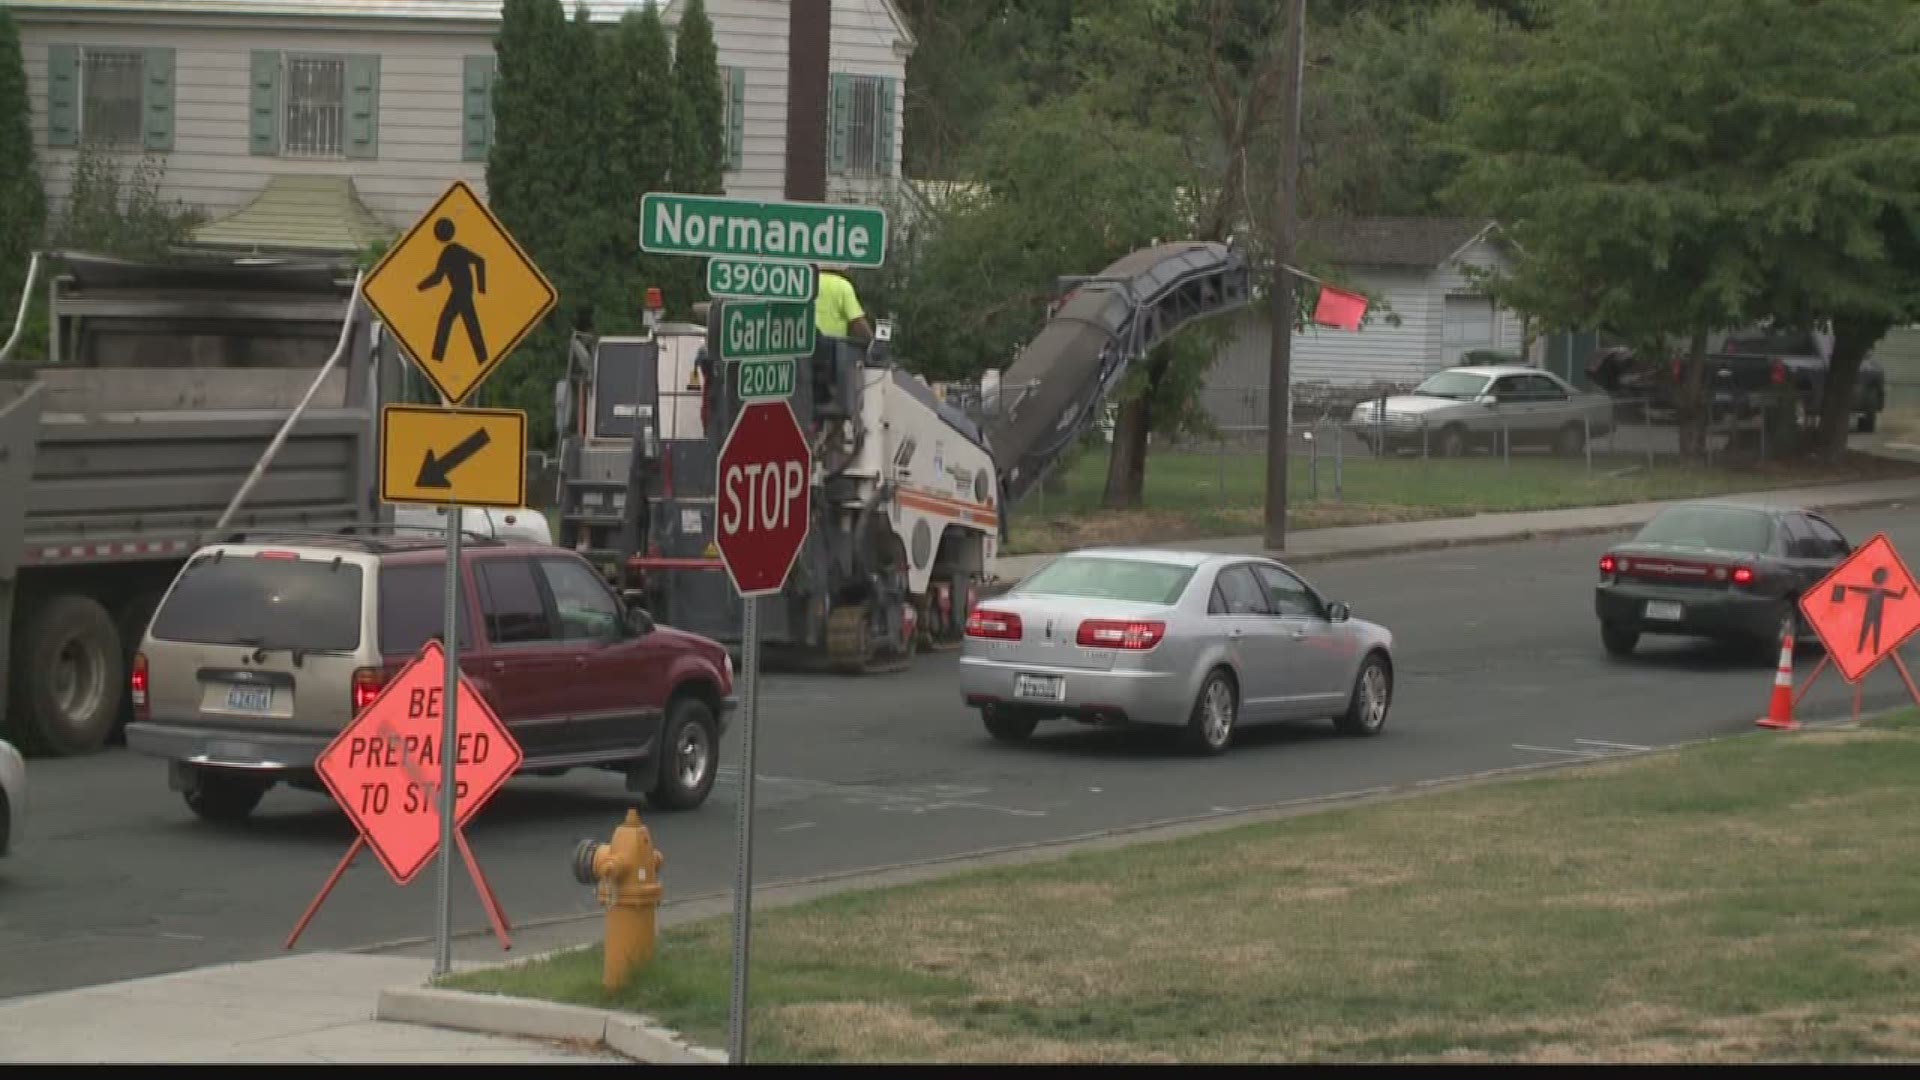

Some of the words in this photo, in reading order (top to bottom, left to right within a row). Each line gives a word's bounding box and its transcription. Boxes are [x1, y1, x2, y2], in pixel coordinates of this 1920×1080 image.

[655, 203, 869, 257] Normandie
[717, 263, 805, 296] 3900N
[730, 309, 808, 351] Garland
[743, 364, 790, 393] 200W
[723, 461, 803, 535] STOP
[408, 687, 443, 719] BE
[348, 733, 489, 769] PREPAED
[361, 784, 389, 815] TO
[403, 781, 468, 815] STP
